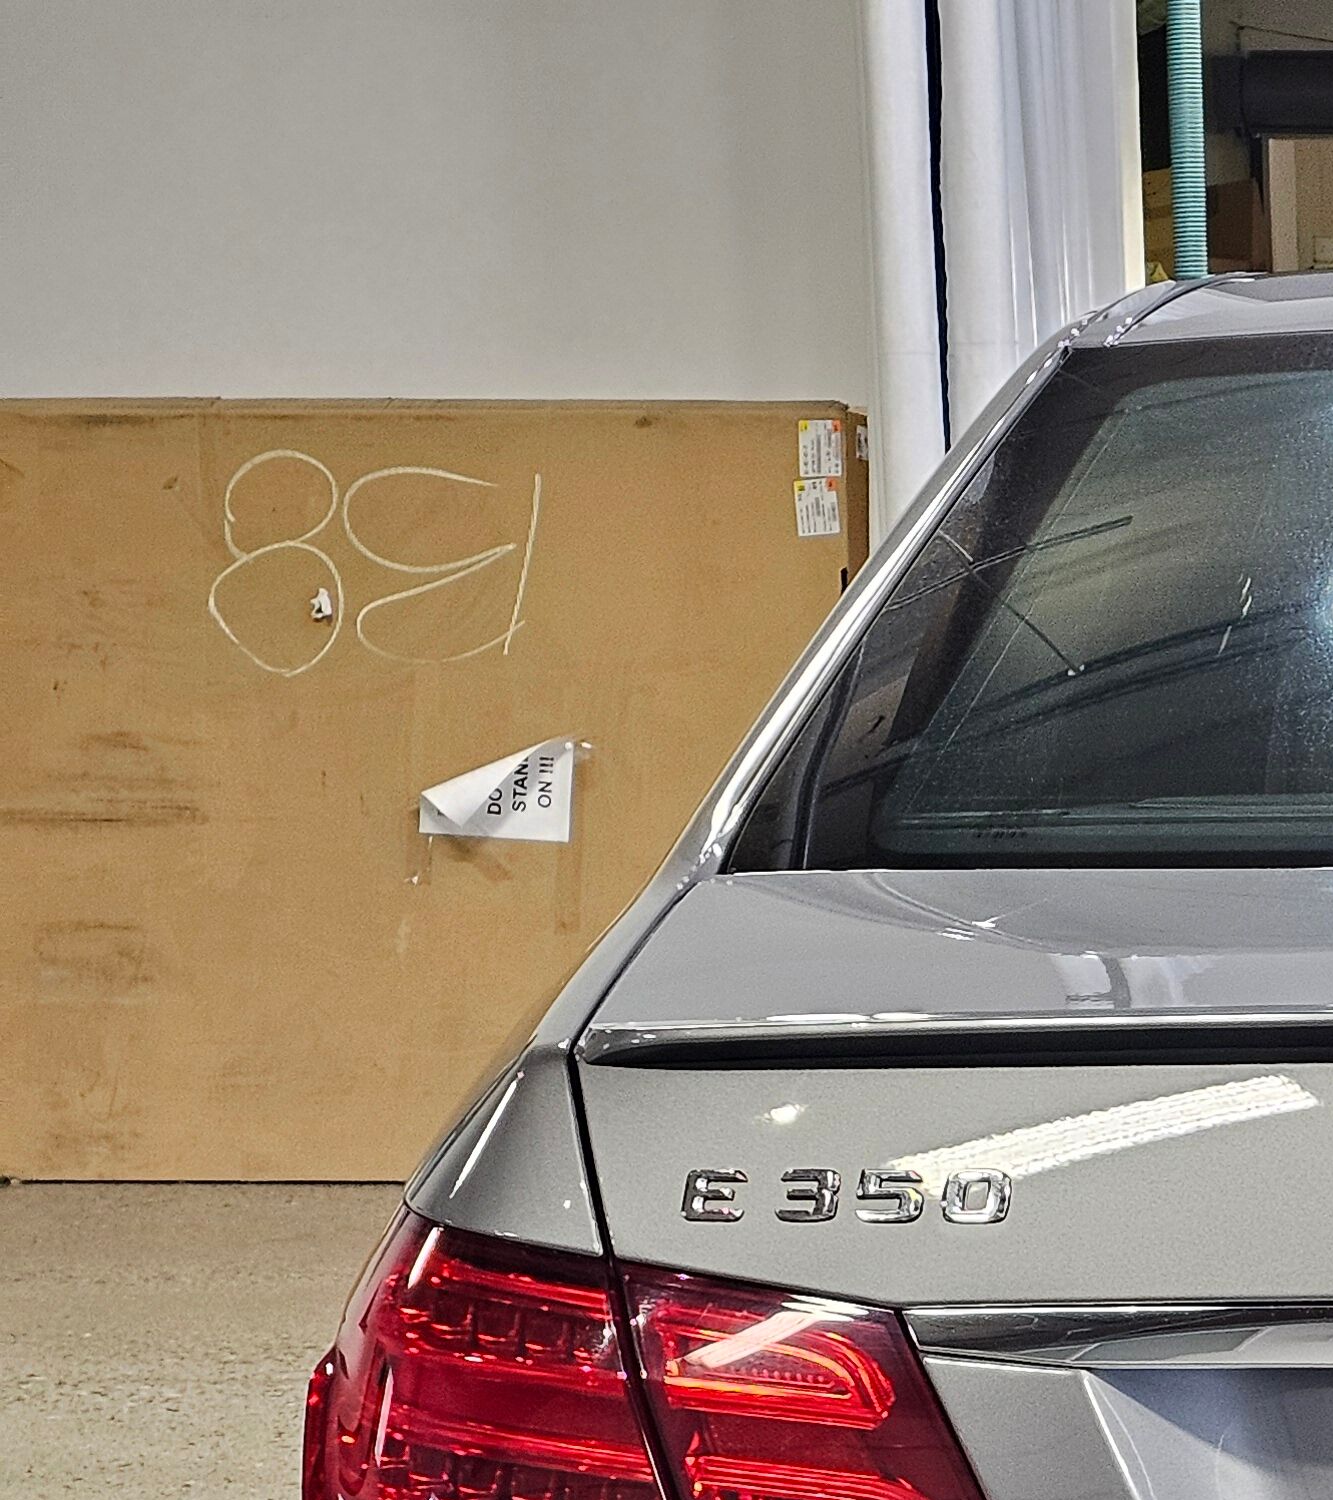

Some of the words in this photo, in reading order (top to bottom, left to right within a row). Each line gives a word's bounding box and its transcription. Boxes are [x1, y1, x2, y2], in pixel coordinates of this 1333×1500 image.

[511, 756, 529, 812] STAN
[537, 781, 553, 808] ON
[681, 1168, 748, 1222] E
[774, 1168, 1013, 1224] 350
